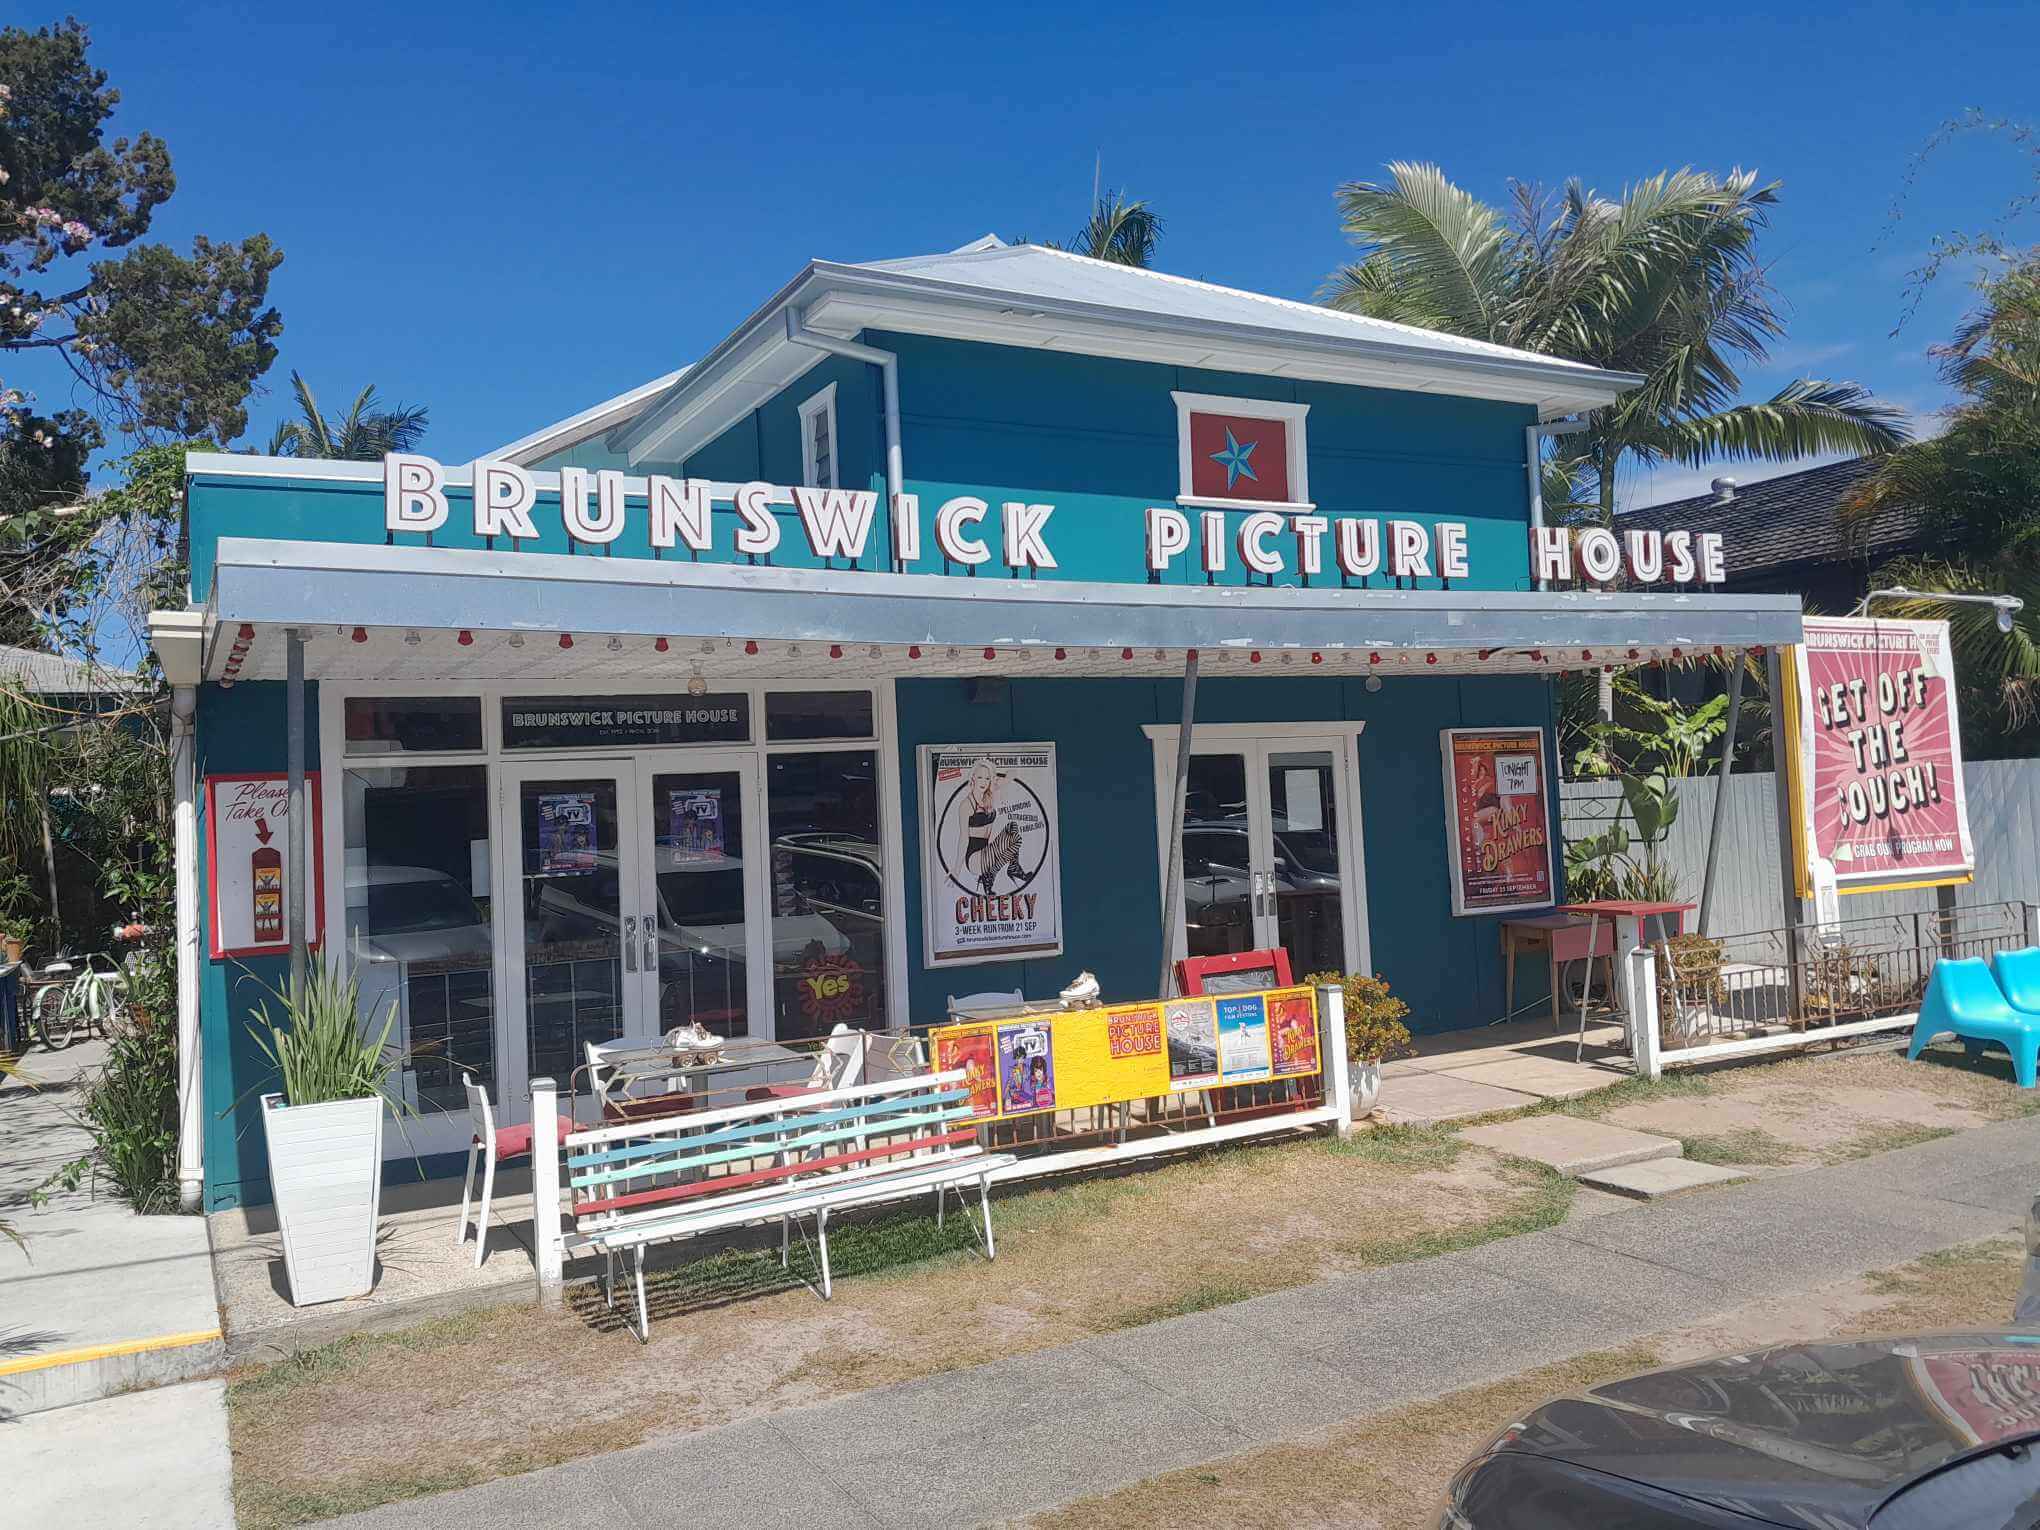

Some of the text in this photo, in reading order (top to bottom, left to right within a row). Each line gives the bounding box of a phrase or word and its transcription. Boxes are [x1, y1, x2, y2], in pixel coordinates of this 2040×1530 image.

[384, 452, 1725, 583] BRUNSWICK PICTURE HOUSE
[1866, 633, 1907, 649] PICTURE
[1817, 667, 1928, 730] GET OFF
[512, 709, 738, 727] BRUNSWICK PICTURE HOUSE
[1847, 721, 1909, 772] THE
[1020, 756, 1049, 766] HOUSE
[1500, 760, 1531, 776] TONIGHT
[235, 782, 288, 802] Please
[1838, 761, 1941, 830] COUCH!
[225, 801, 265, 822] Take
[567, 810, 580, 820] TV
[695, 805, 708, 815] TV
[1488, 803, 1528, 840] KINKY
[1481, 827, 1545, 872] DRAWERS
[1855, 844, 1876, 858] GRAB
[1896, 840, 1934, 855] PROGRAM
[1935, 838, 1954, 852] NOW
[1506, 884, 1537, 892] SEPTEMBER
[955, 892, 1038, 925] CHEEKY
[955, 922, 1037, 936] 3-WEEK RUN FROM 21 SEP
[806, 974, 849, 1000] Yes
[1224, 1003, 1257, 1014] TOP DOG
[1109, 1021, 1160, 1038] PICTURE
[1024, 1040, 1038, 1050] TV
[1110, 1034, 1161, 1055] HOUSE
